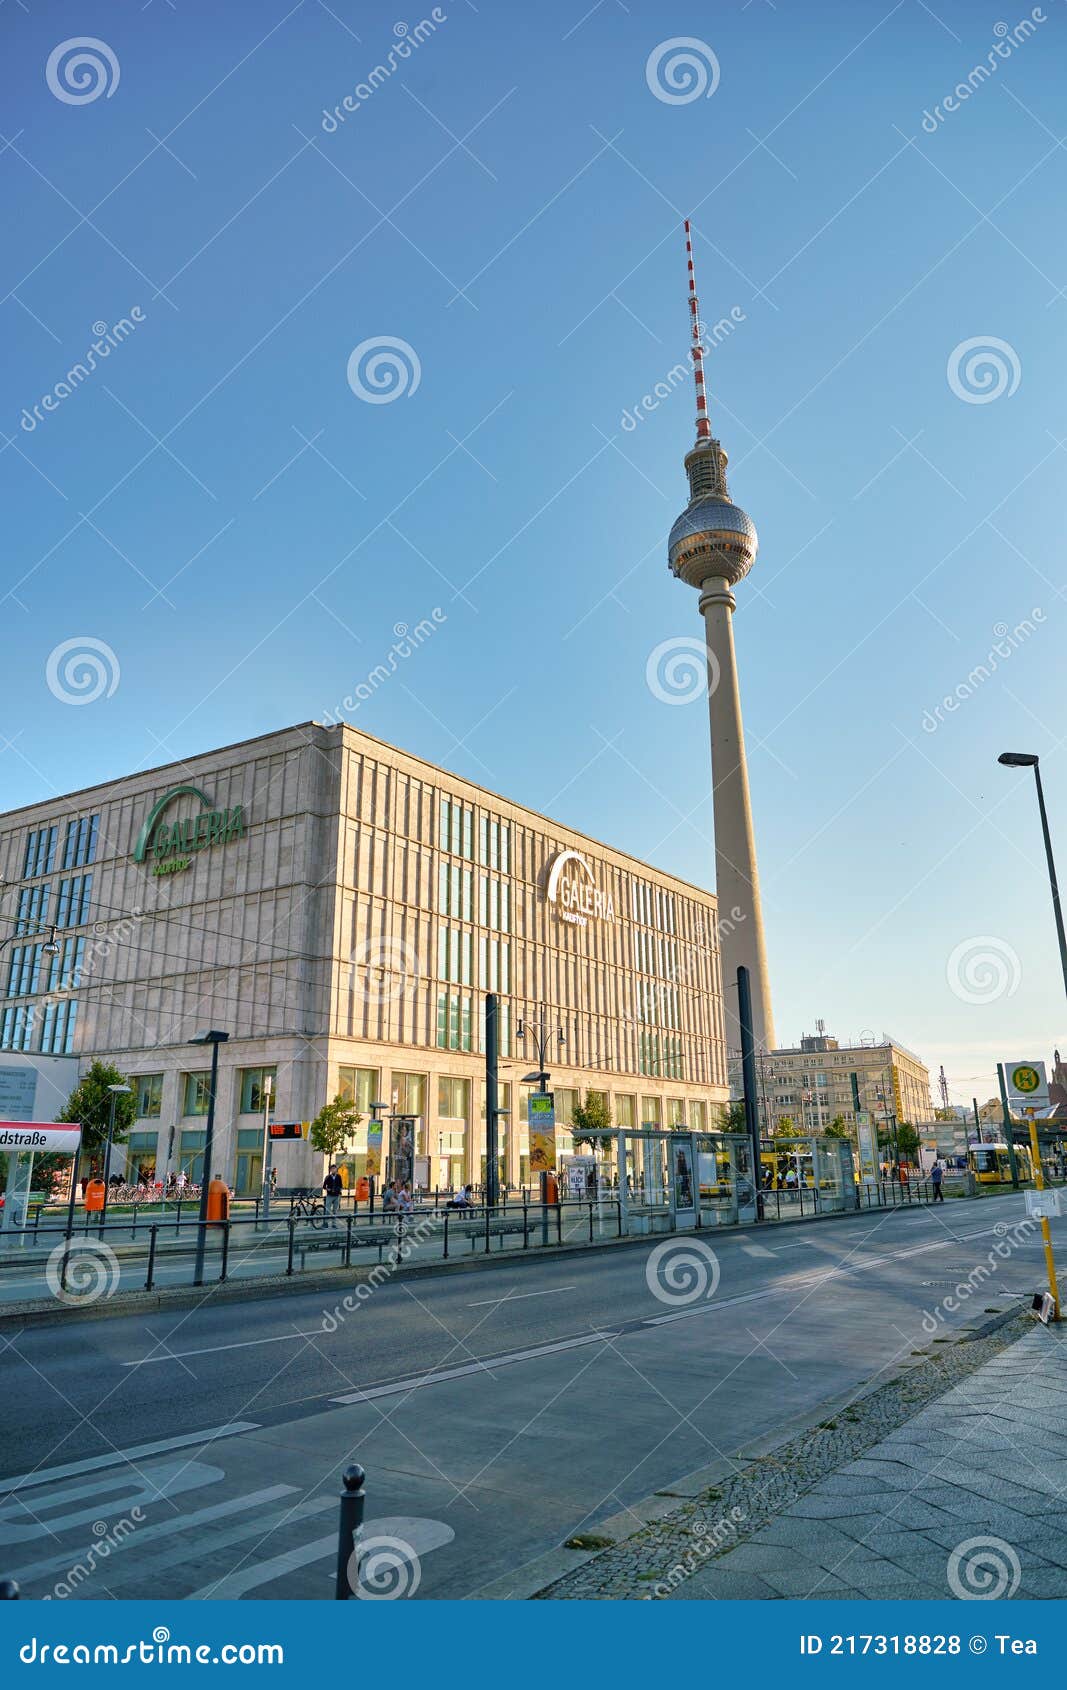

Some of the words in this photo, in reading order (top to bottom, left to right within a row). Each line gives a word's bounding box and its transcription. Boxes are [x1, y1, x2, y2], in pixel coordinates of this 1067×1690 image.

[153, 805, 246, 859] GALERIA
[560, 876, 617, 924] GALERIA
[0, 1130, 47, 1146] dstraße
